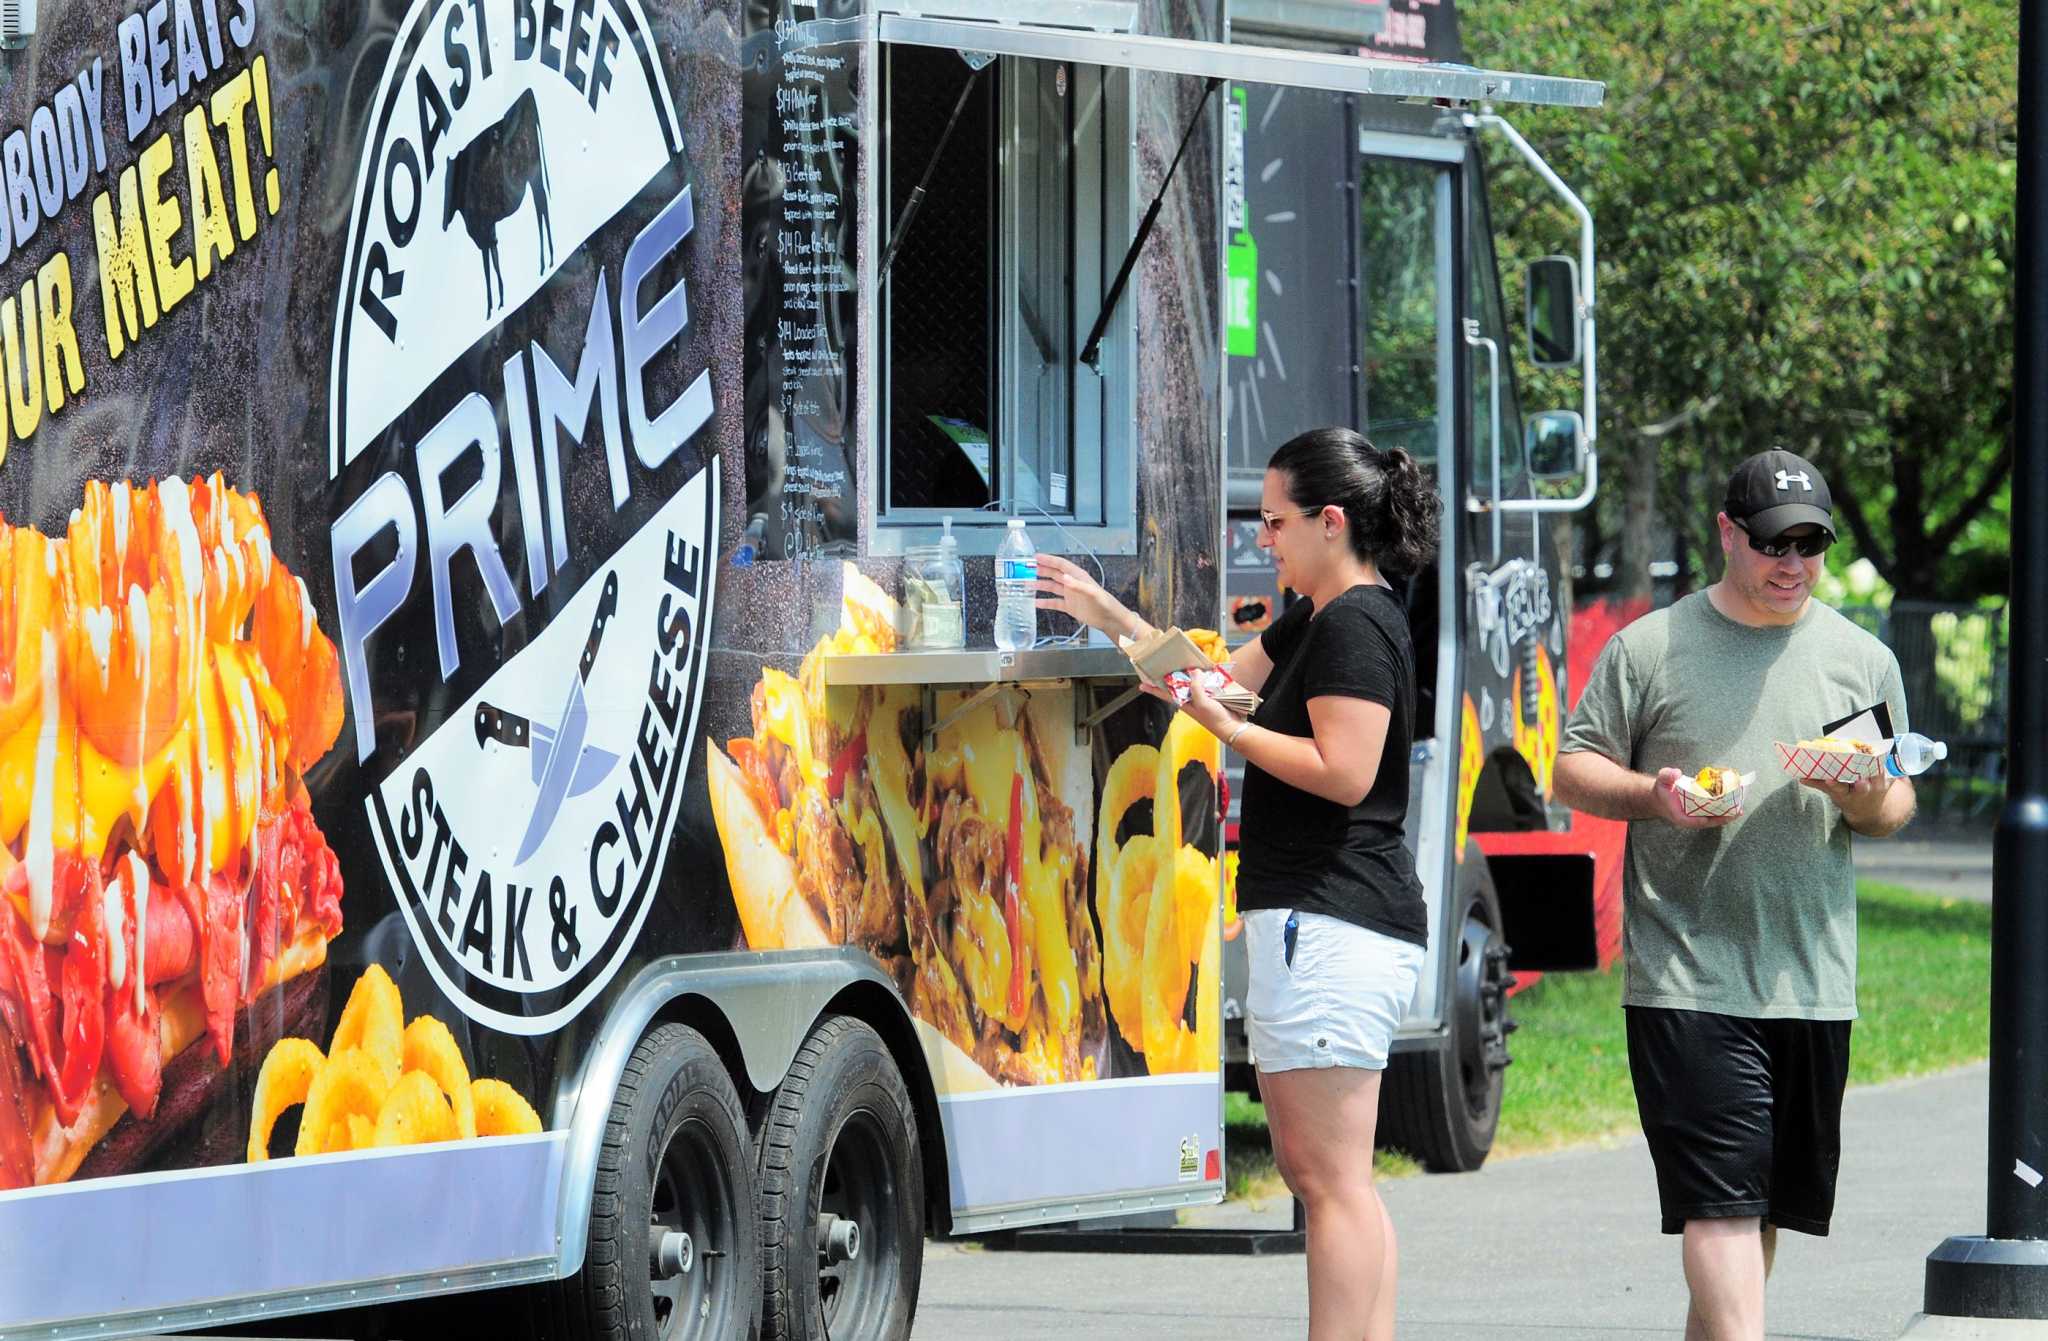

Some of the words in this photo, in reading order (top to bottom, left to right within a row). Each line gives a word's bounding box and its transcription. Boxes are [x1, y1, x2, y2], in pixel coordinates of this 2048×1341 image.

[91, 54, 281, 360] MEAT!
[359, 0, 494, 344] ROAST
[514, 0, 620, 112] BEEF
[777, 228, 793, 263] $14
[330, 184, 714, 767] PRIME
[400, 766, 533, 982] STEAK
[549, 875, 581, 973] &
[589, 529, 700, 918] CHEESE
